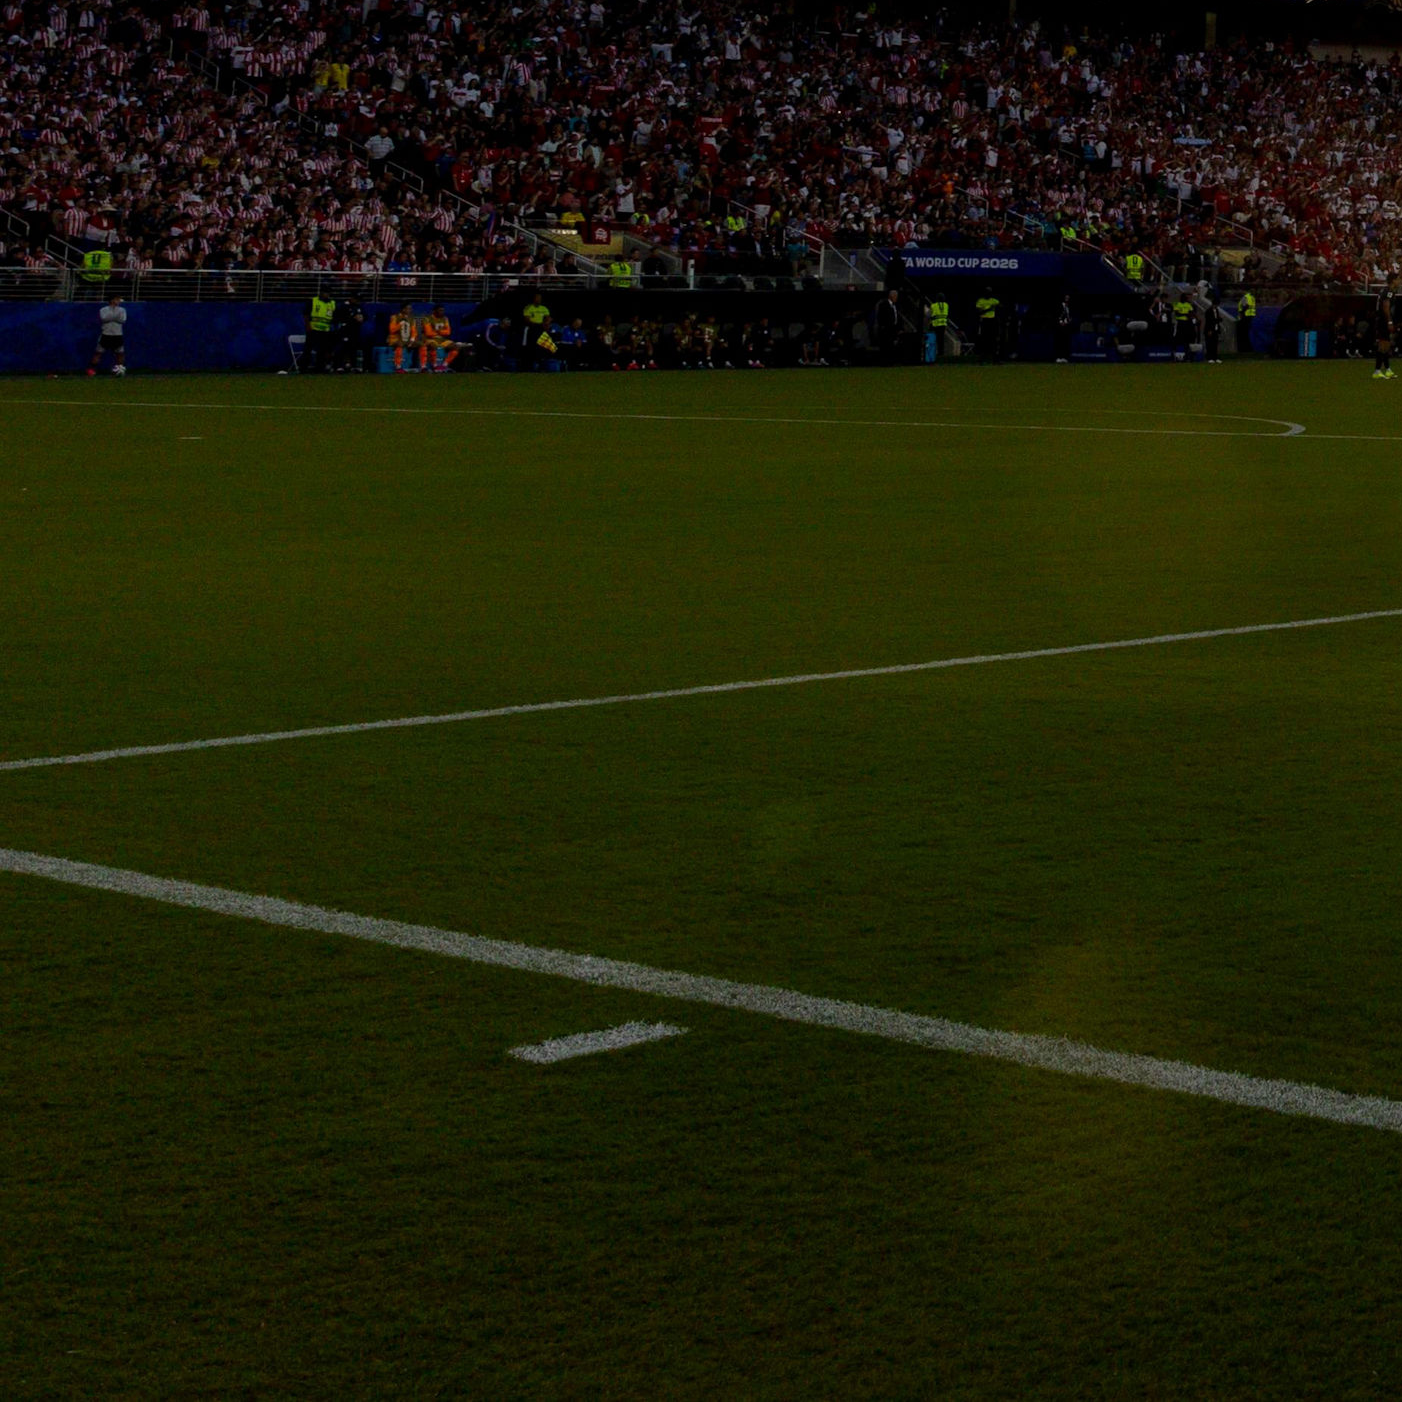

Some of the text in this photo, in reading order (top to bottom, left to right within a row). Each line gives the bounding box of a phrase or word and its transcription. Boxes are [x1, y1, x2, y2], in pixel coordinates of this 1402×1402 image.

[915, 257, 956, 268] WORLD
[957, 257, 980, 268] CUP
[980, 258, 1019, 269] 2026
